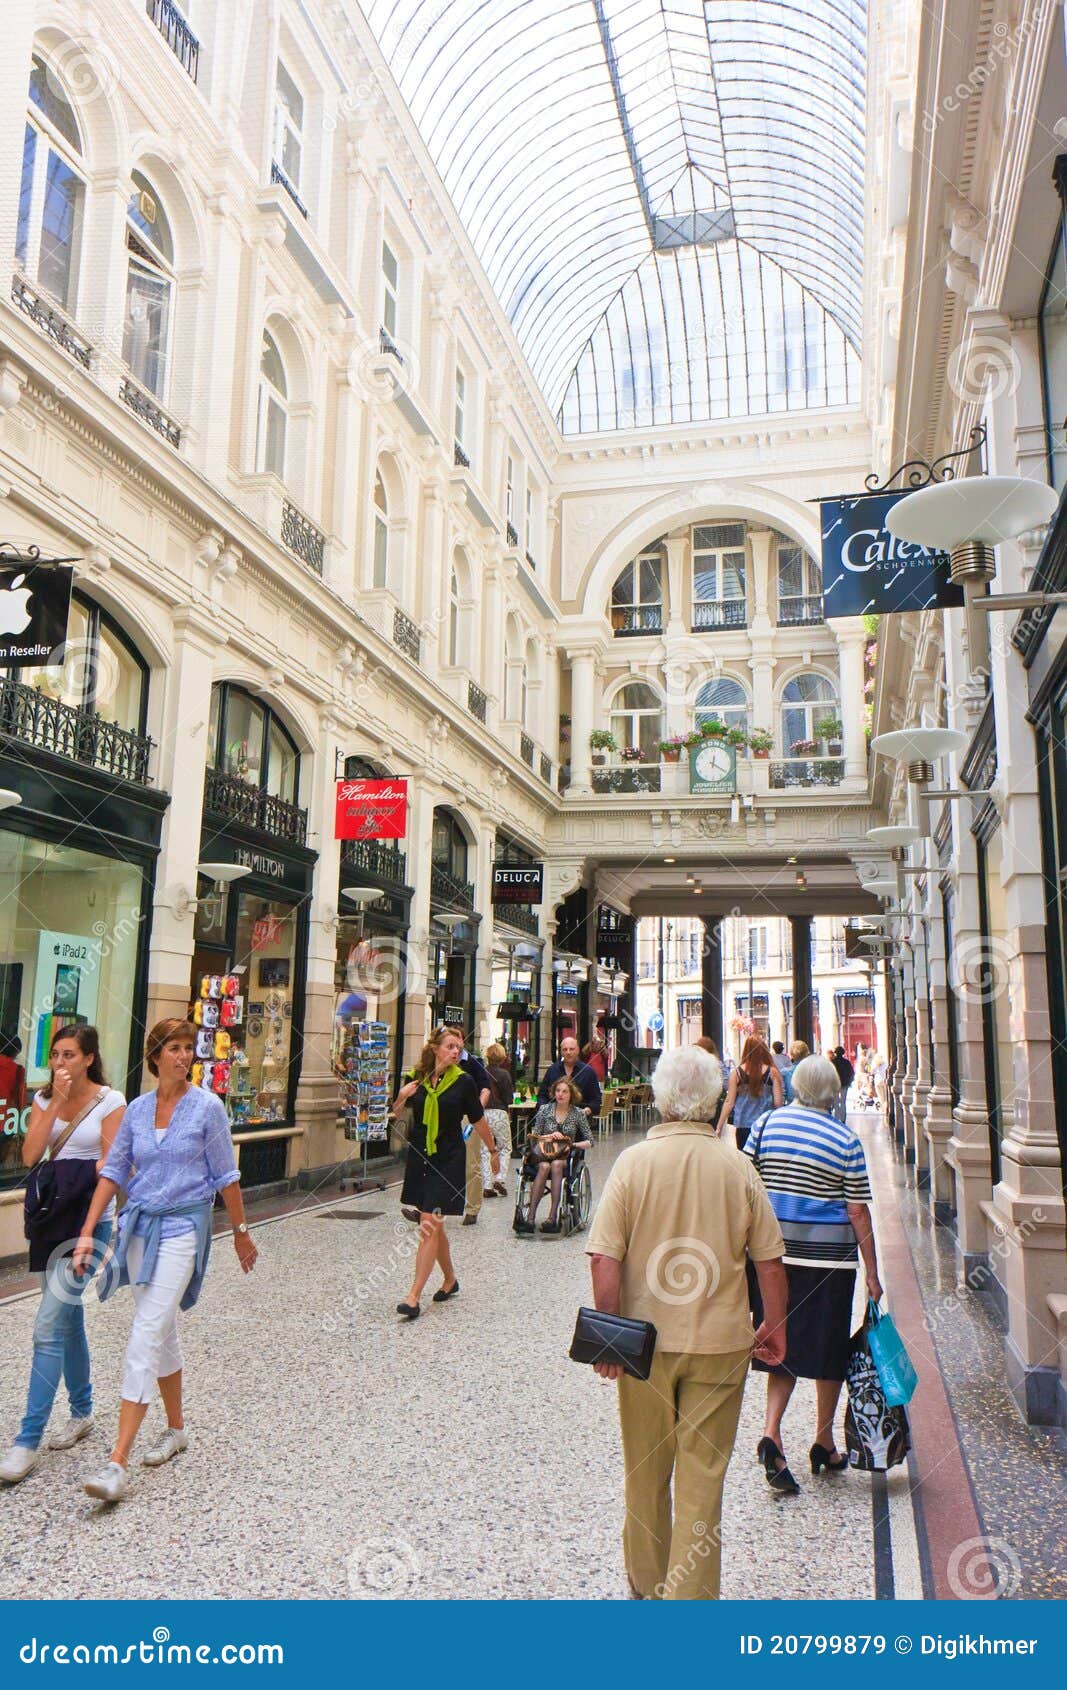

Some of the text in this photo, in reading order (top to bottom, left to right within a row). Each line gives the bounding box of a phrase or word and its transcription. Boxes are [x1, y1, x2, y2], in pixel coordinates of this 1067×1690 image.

[841, 528, 950, 572] Calex
[10, 644, 52, 656] Reseller
[338, 785, 405, 800] Hamilton
[238, 849, 285, 878] HAMILTON
[495, 872, 540, 882] DELUCA
[598, 934, 631, 943] DELUCA
[62, 943, 87, 959] iPad 2
[445, 1008, 463, 1023] DELUCA
